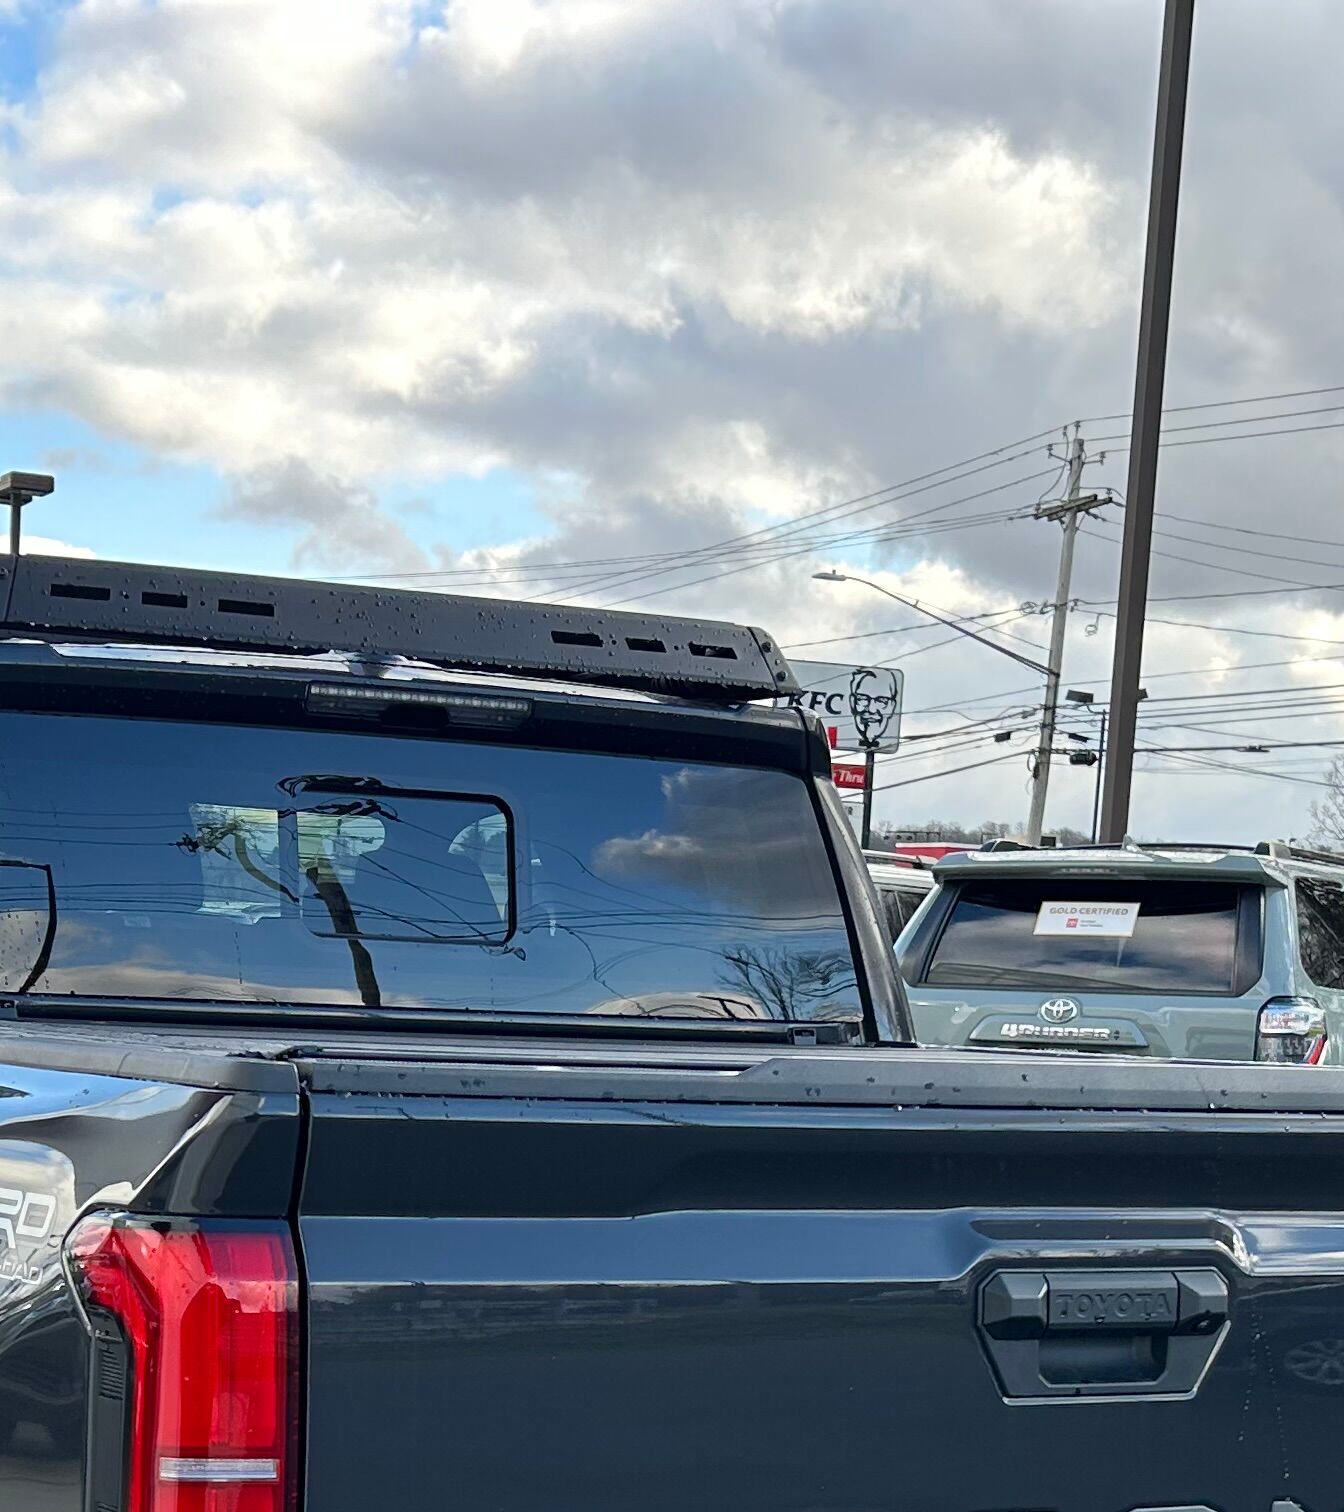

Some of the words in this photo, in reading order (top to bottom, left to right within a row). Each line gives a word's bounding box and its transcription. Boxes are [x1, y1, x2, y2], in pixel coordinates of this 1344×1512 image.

[787, 690, 844, 715] KFC
[1049, 907, 1077, 915] GOLD
[1078, 907, 1129, 916] CERTIFIED
[1000, 1023, 1110, 1041] 4RUNNER
[1056, 1292, 1173, 1319] TOYOTA
